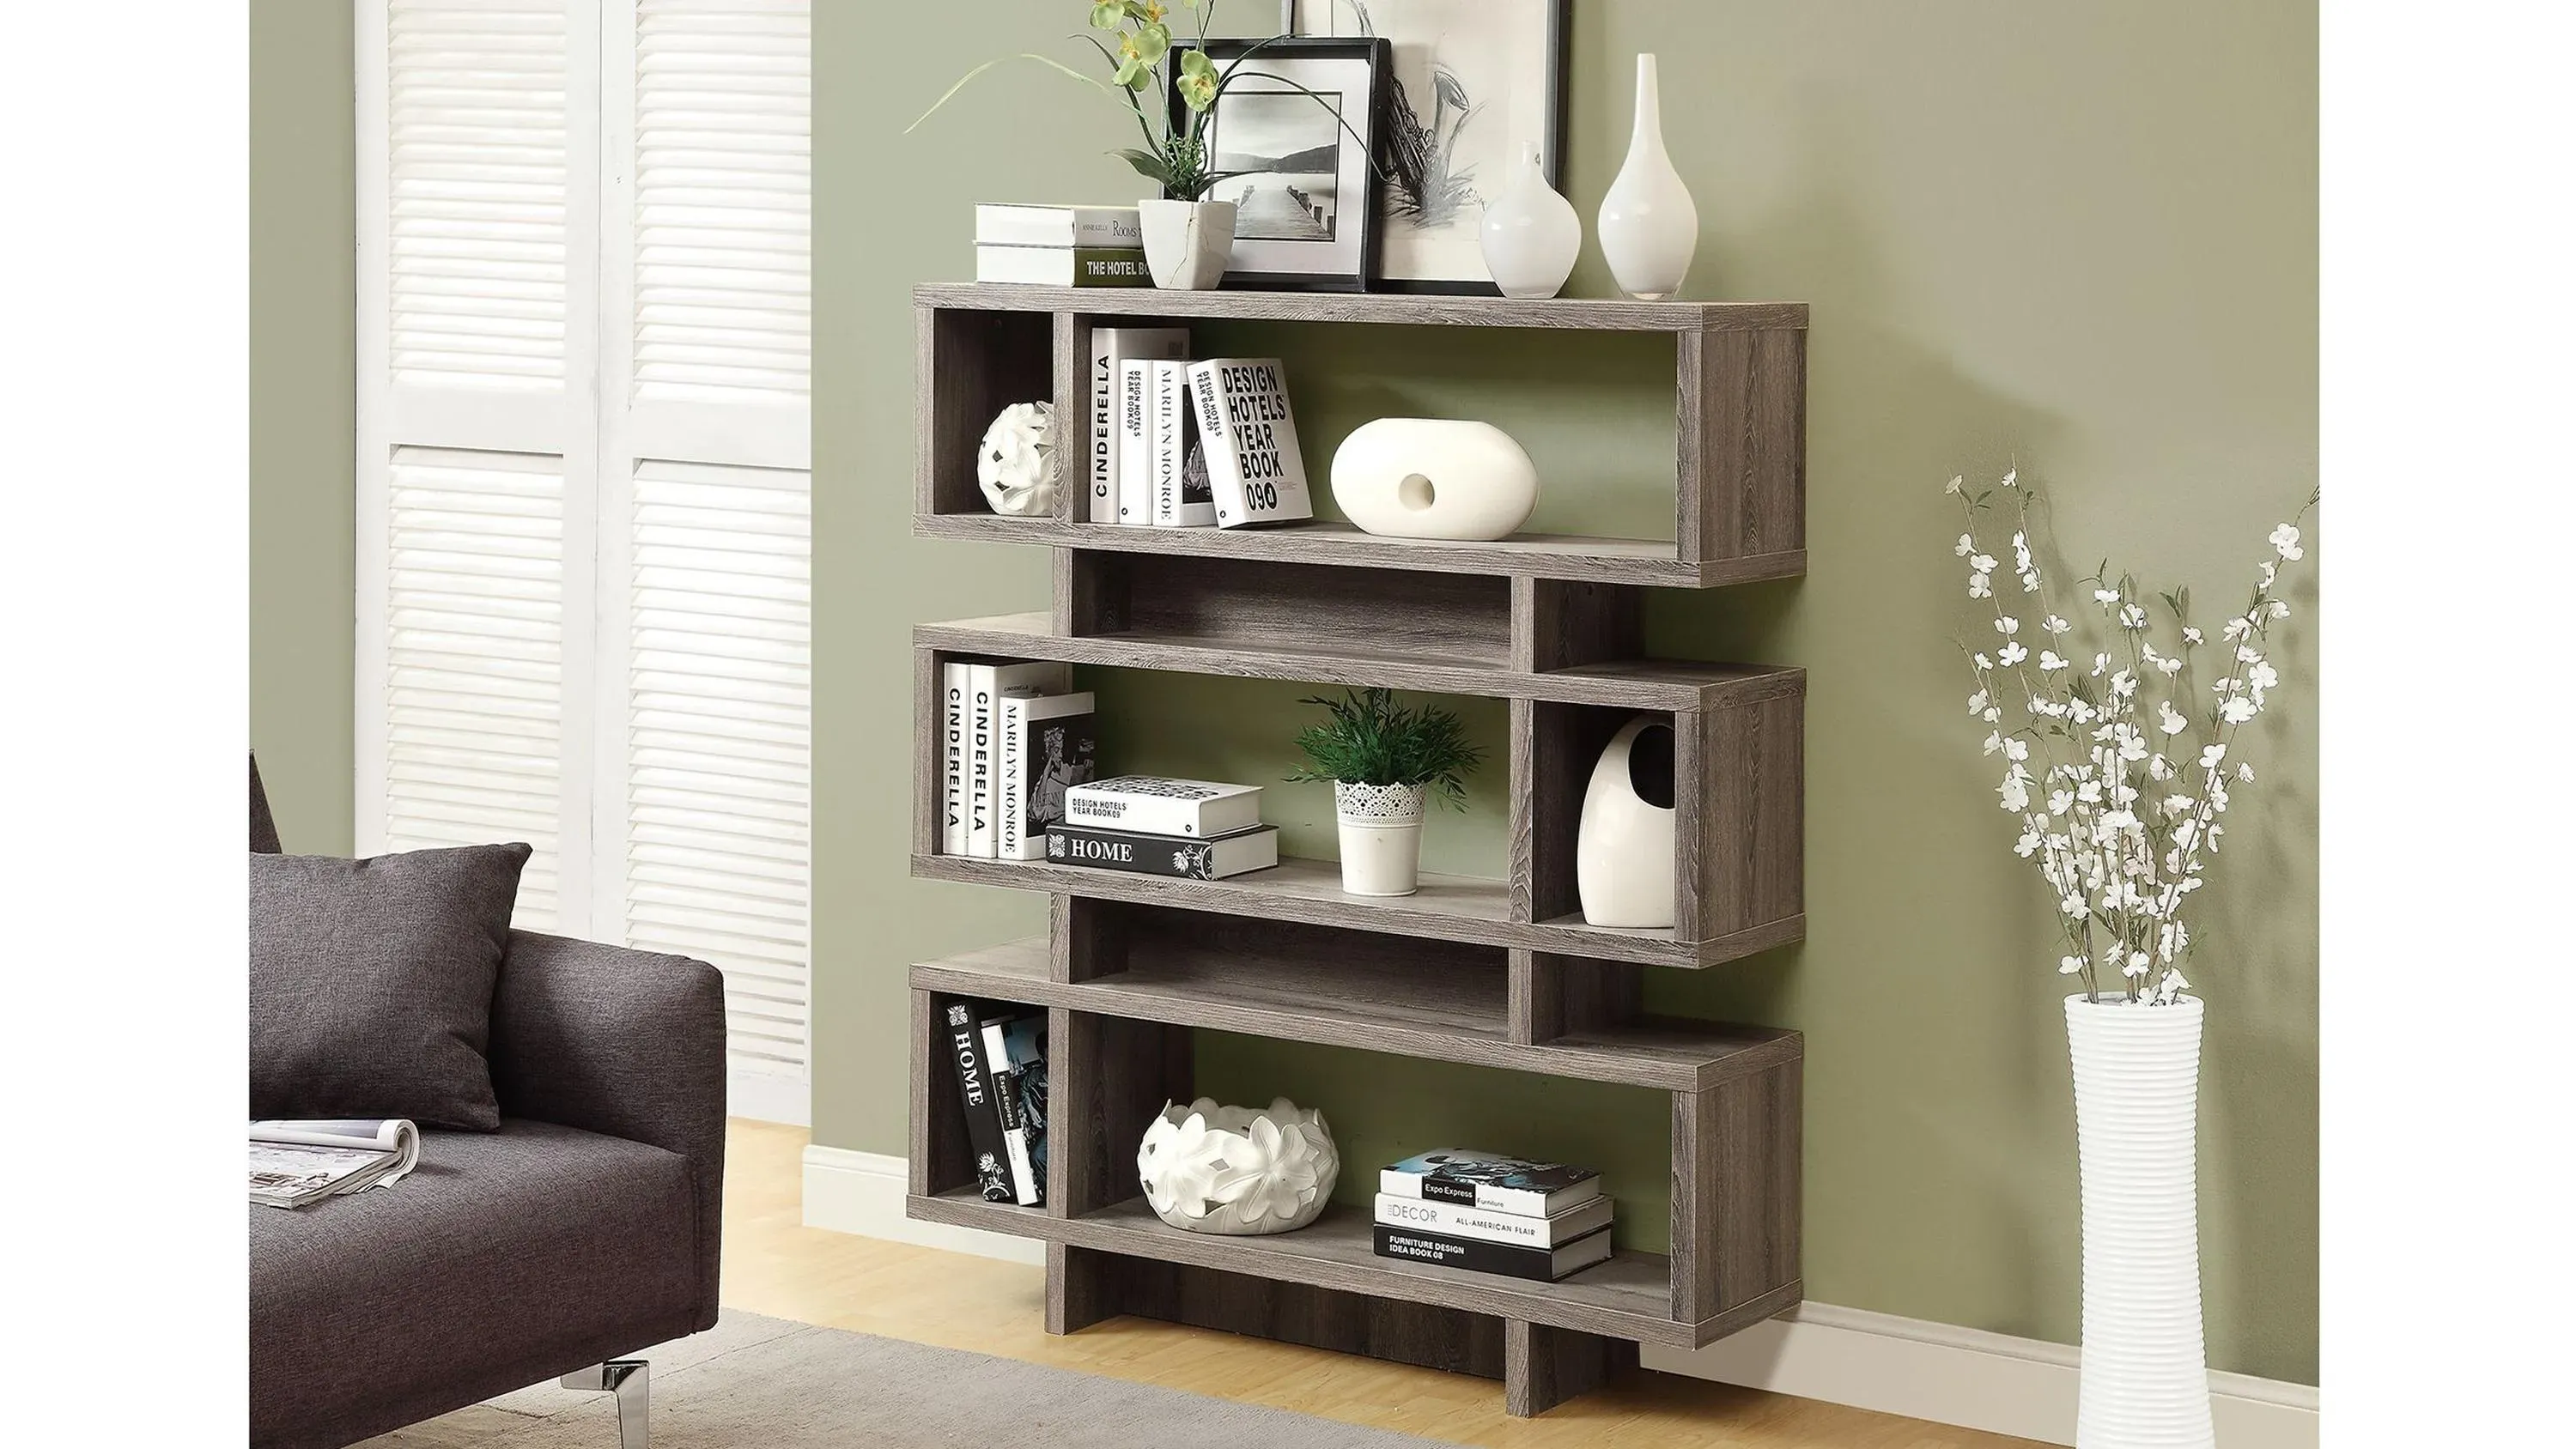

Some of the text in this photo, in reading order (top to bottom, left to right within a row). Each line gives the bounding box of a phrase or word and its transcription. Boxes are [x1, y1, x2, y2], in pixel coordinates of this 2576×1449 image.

[1086, 261, 1106, 276] THE
[1107, 261, 1137, 276] HOTEL
[1196, 373, 1206, 395] YEAR
[1221, 366, 1278, 394] DESIGN
[1202, 370, 1223, 438] DESIGN HOTELS
[1227, 394, 1286, 422] HOTELS
[1096, 355, 1109, 498] CINDERELLA
[1232, 423, 1276, 452] YEAR
[1161, 369, 1172, 519] MARILYN MONROE
[1239, 451, 1285, 480] BOOK
[949, 688, 961, 828] CINDERELLA
[974, 691, 988, 831] CINDERELLA
[1005, 705, 1018, 853] MARILYN MONROE
[1072, 798, 1097, 808] DESIGN
[1100, 801, 1127, 810] HOTELS
[1072, 807, 1091, 815] YEAR
[1071, 839, 1133, 863] HOME
[954, 1030, 985, 1107] HOME
[999, 1075, 1014, 1127] Expo Express
[1425, 1184, 1473, 1198] Expo Express
[1392, 1203, 1437, 1223] DECOR
[1455, 1217, 1536, 1236] ALL-AMERICAN FLAIR
[1389, 1235, 1465, 1254] FURNITURE DESIGN
[1389, 1244, 1409, 1254] IDEA
[1409, 1246, 1432, 1258] BOOK
